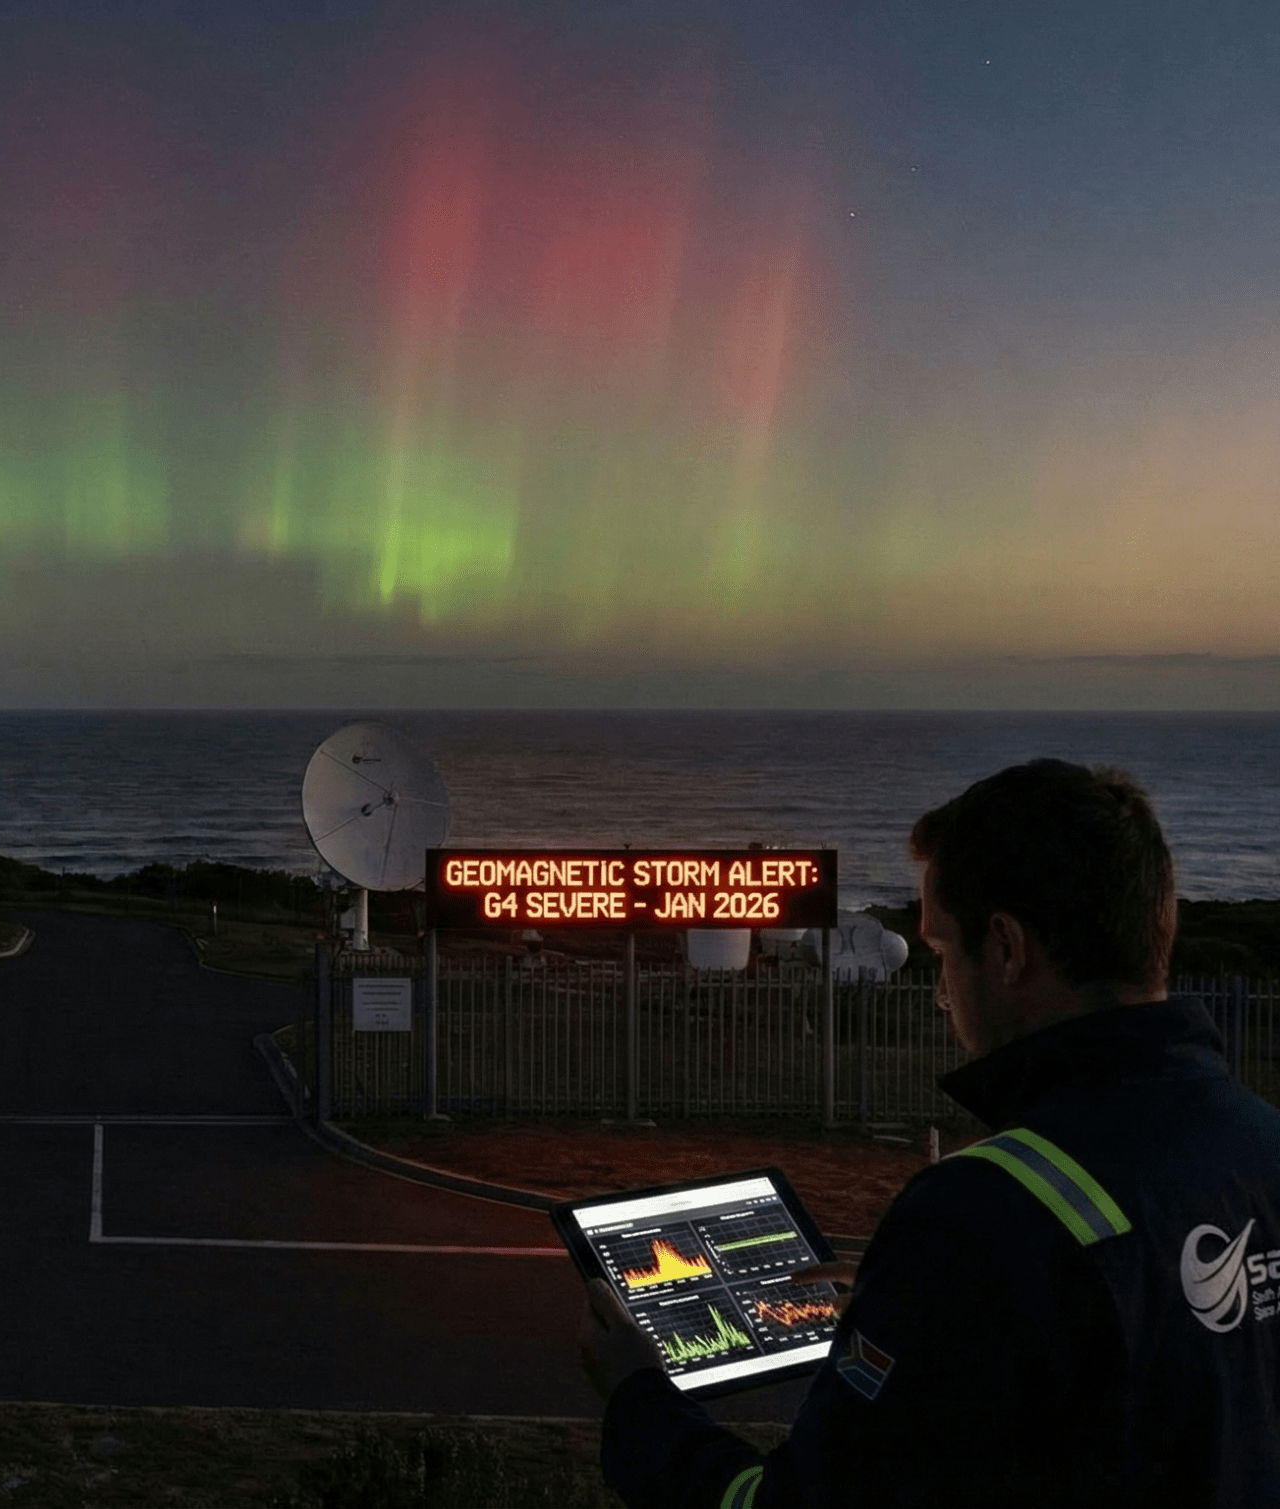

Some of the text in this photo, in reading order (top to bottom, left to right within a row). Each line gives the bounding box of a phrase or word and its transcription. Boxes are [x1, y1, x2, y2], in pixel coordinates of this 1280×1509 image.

[446, 860, 818, 887] GEOMAGNETIC STORM ALERT:
[484, 892, 518, 918] G4
[526, 892, 626, 918] SEVERE
[654, 892, 706, 918] JAN
[713, 892, 780, 918] 2026
